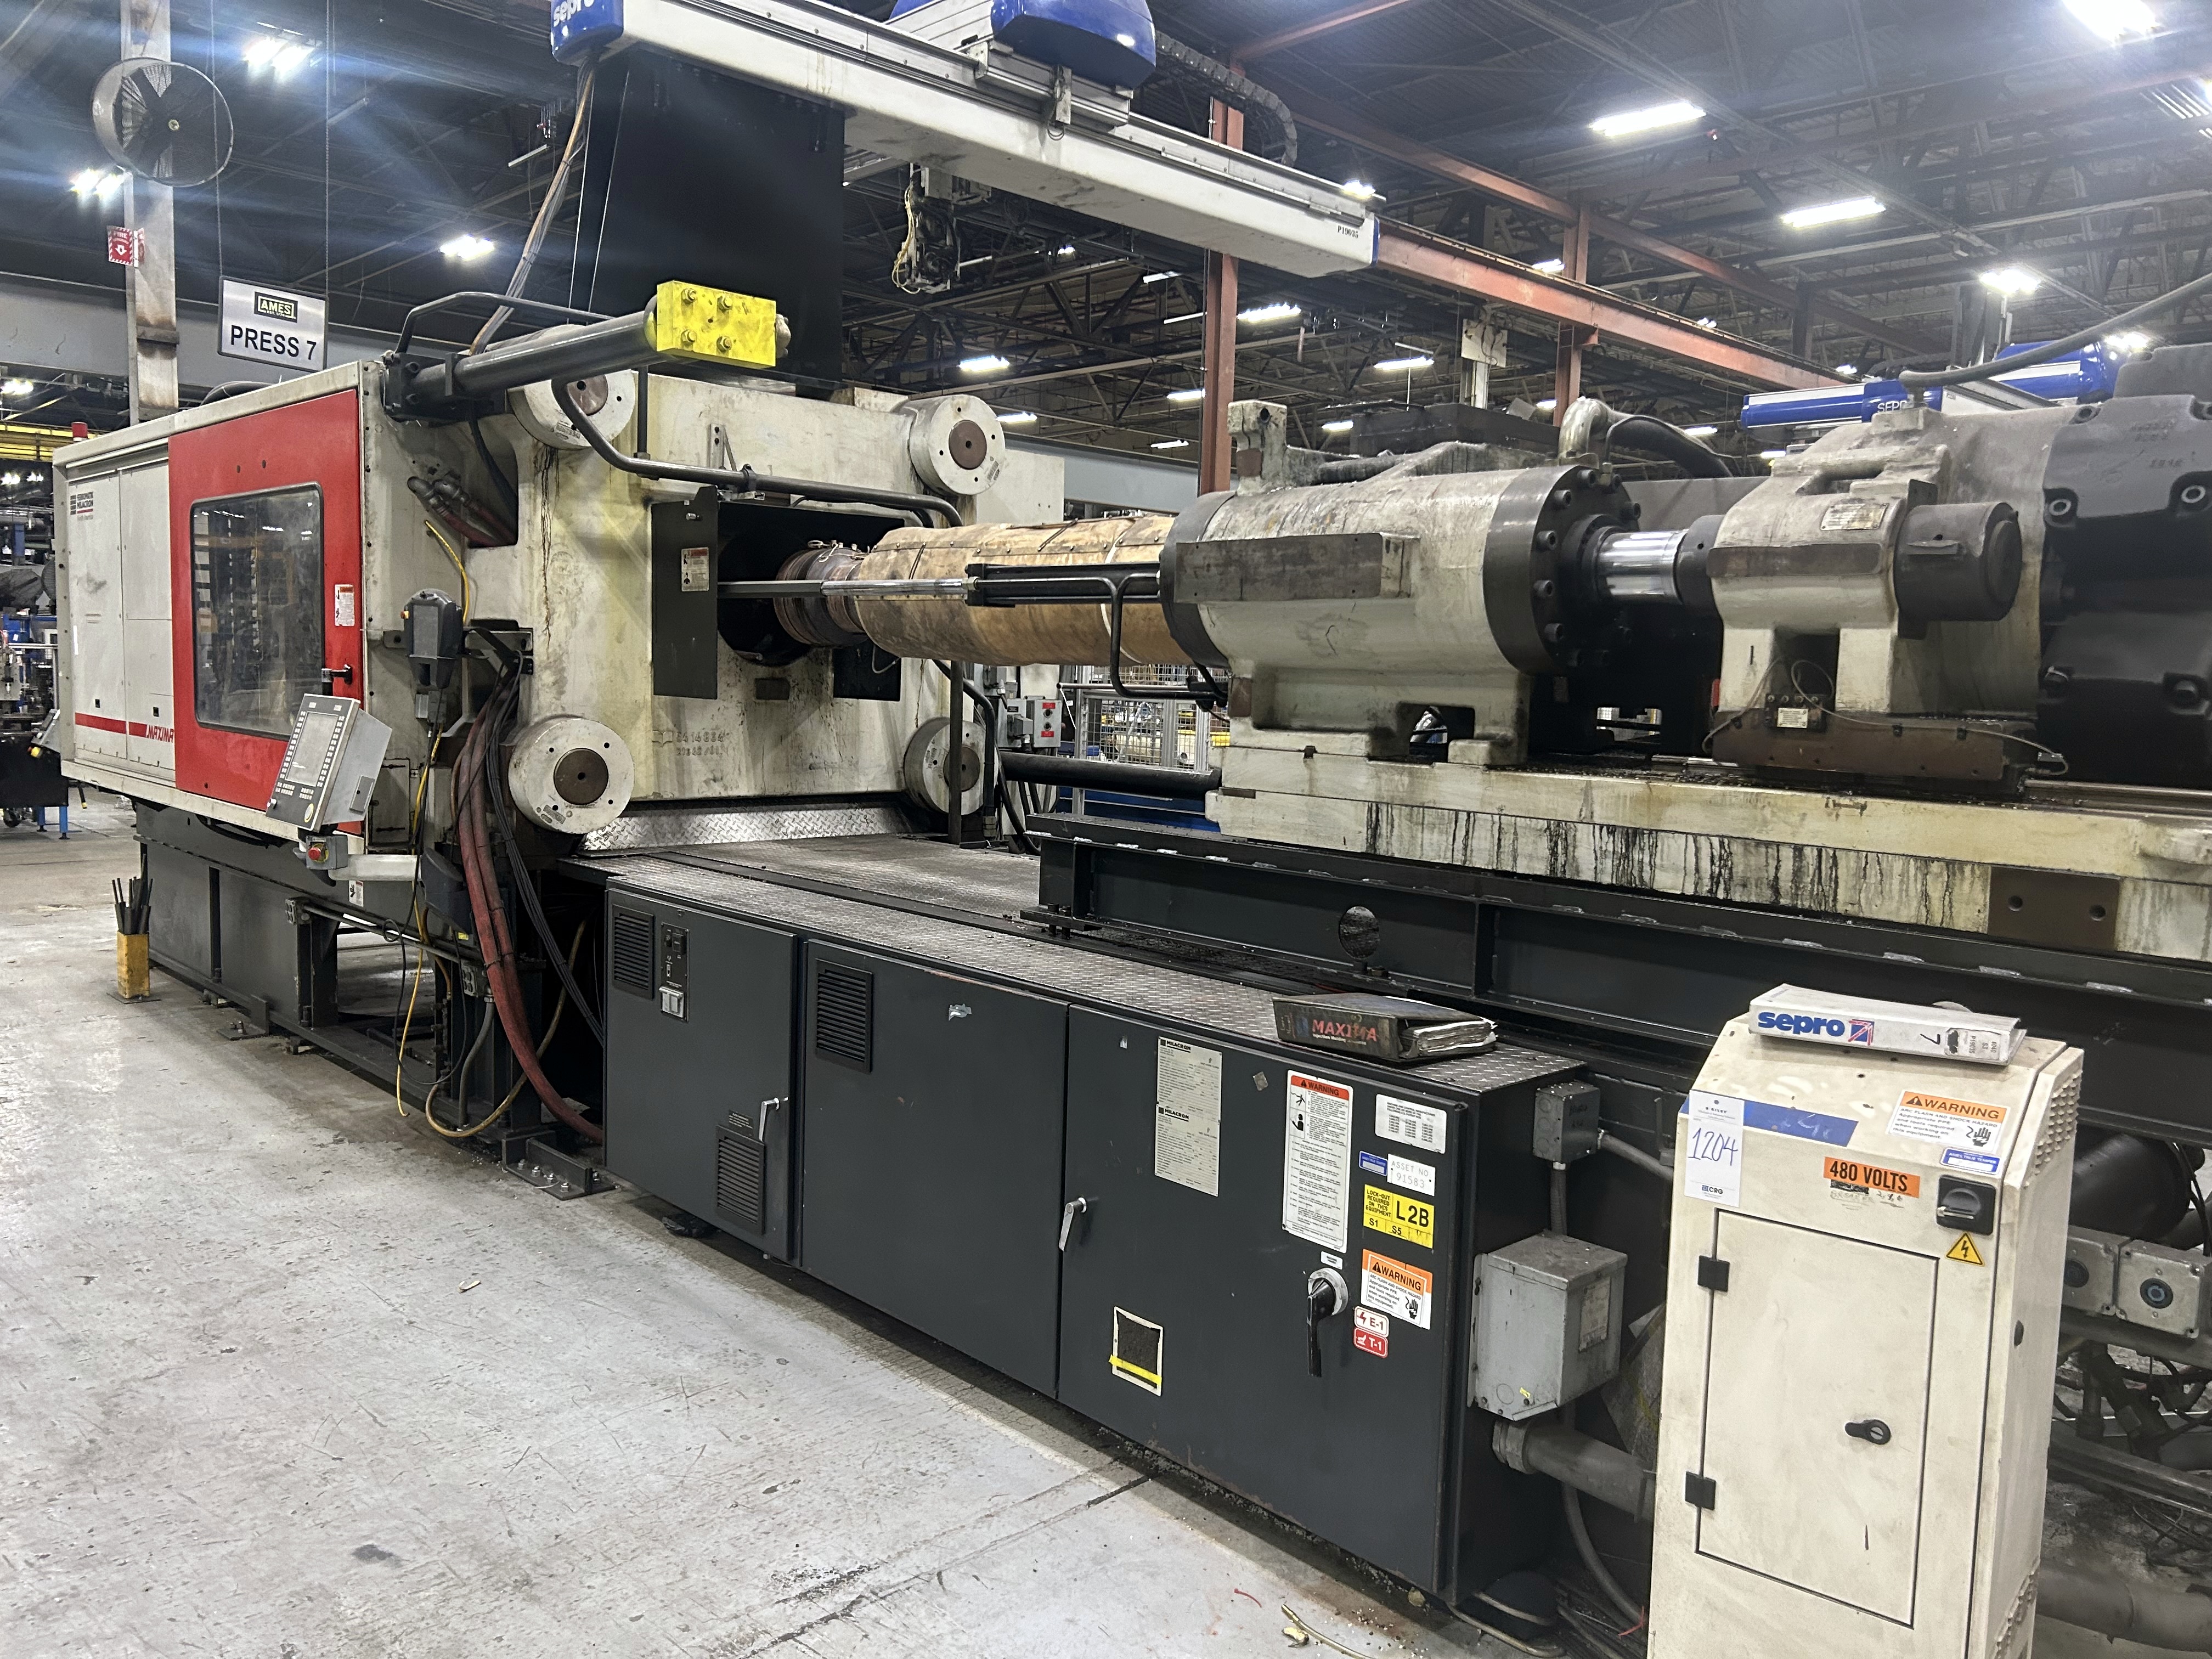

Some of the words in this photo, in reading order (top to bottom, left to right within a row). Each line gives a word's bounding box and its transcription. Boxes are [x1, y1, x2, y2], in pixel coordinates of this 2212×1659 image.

[112, 230, 128, 239] FIRE
[1338, 225, 1358, 239] P19035
[261, 300, 291, 314] AMES
[230, 324, 299, 357] PRESS
[306, 340, 317, 360] 7
[1758, 1012, 1845, 1037] sepro
[1920, 1033, 1940, 1045] 7
[1167, 1041, 1191, 1051] MILACRON
[1308, 1081, 1339, 1096] WARNING
[1165, 1108, 1189, 1120] MILACRON
[1925, 1099, 2000, 1119] WARNING
[1899, 1113, 1936, 1122] Appropriate
[1914, 1125, 1939, 1134] working
[1927, 1122, 1954, 1131] required
[1688, 1127, 1738, 1166] 1204
[1391, 1160, 1414, 1172] ASSET
[1418, 1168, 1429, 1177] NO
[1396, 1172, 1424, 1188] 91583
[1830, 1160, 1858, 1181] 480
[1863, 1166, 1908, 1192] VOLTS
[1367, 1189, 1390, 1201] LOCK-OUT
[1367, 1195, 1390, 1206] REQUIRED
[1365, 1205, 1391, 1217] EQUIPMENT
[1396, 1200, 1429, 1227] L2B
[1369, 1218, 1378, 1227] S1
[1392, 1226, 1402, 1235] S5
[1381, 1265, 1421, 1291] WARNING
[1369, 1279, 1390, 1291] Appropriate
[1378, 1294, 1392, 1303] working
[1385, 1293, 1400, 1301] required
[1407, 1291, 1421, 1300] HAZARD
[1370, 1317, 1384, 1330] E-1
[1368, 1337, 1382, 1351] T-1
